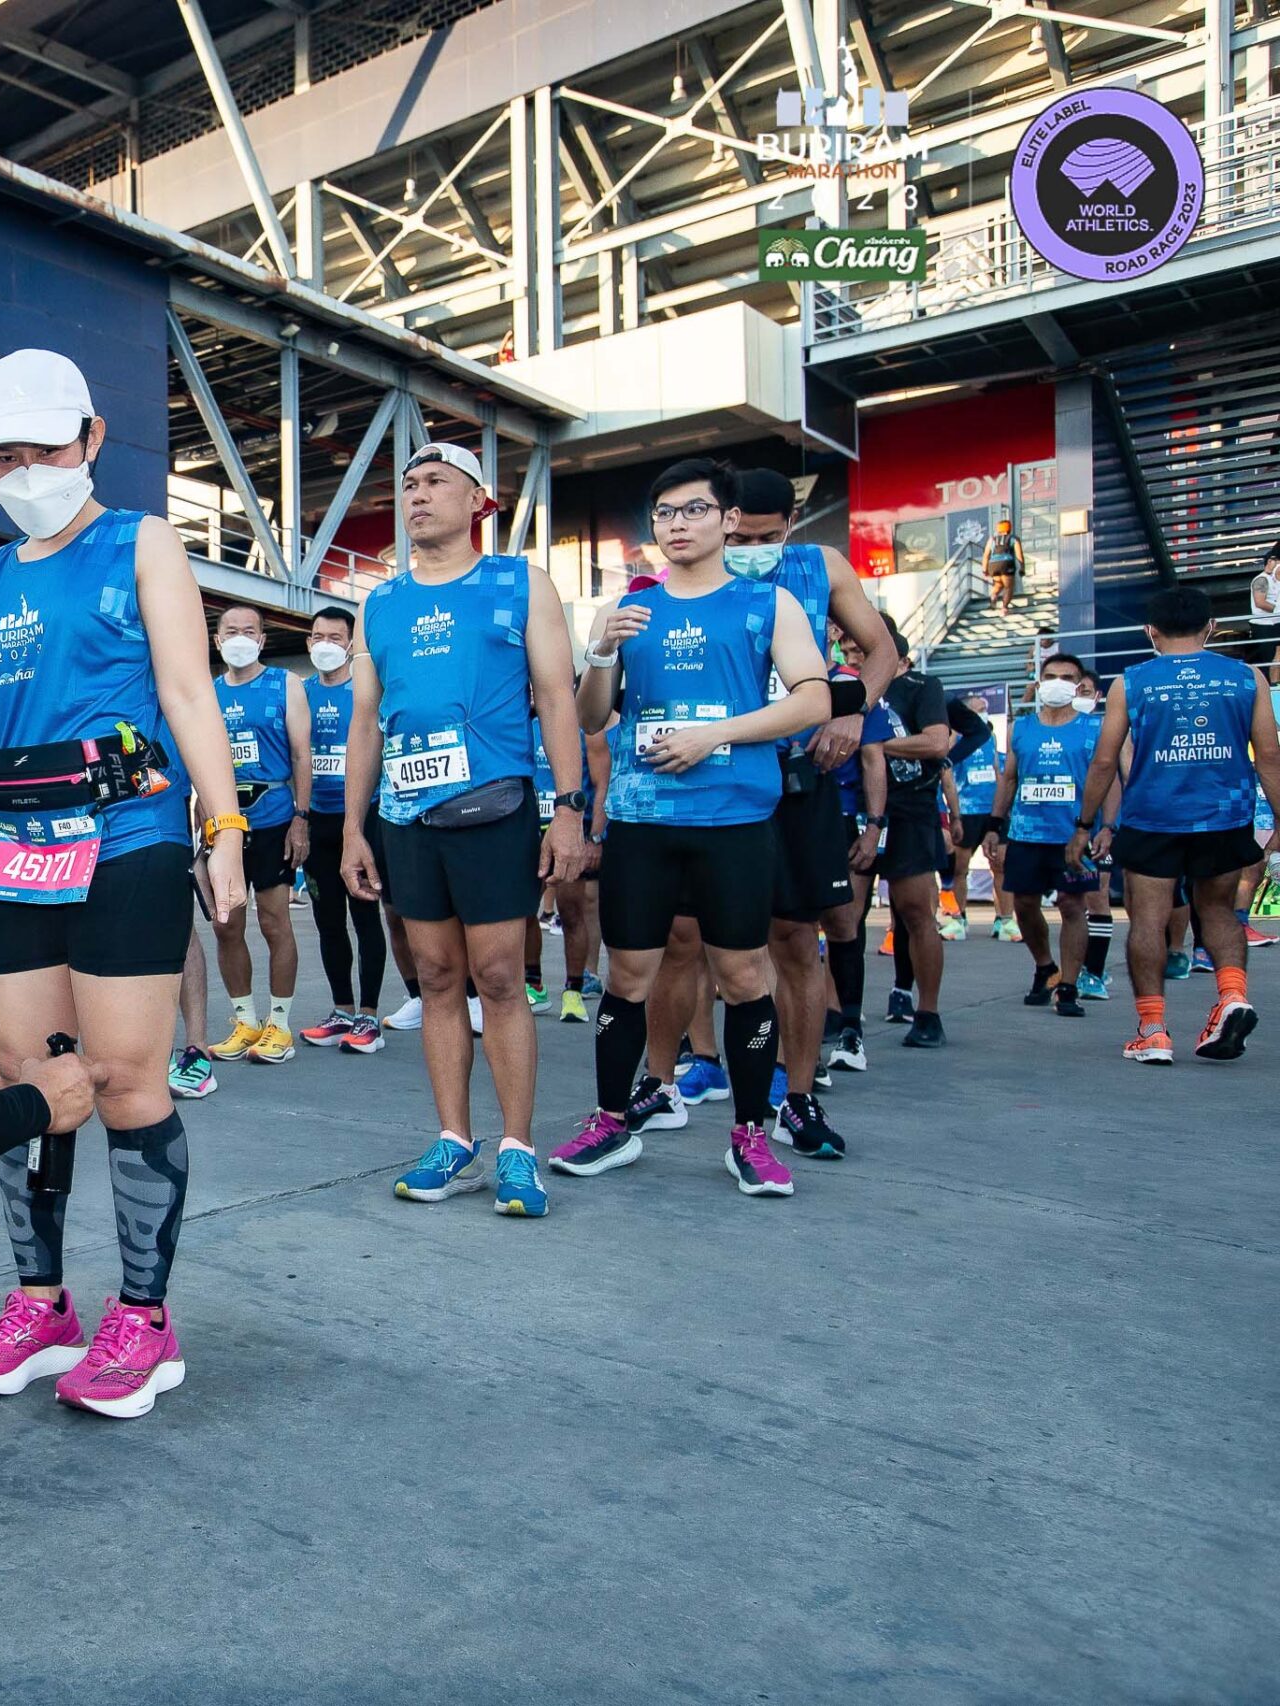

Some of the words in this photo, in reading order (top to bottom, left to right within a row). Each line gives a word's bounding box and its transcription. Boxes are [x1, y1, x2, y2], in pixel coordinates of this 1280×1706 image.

[410, 619, 455, 634] BURIRAM
[662, 635, 707, 647] BURIRAM
[1170, 732, 1216, 748] 42.195
[1155, 746, 1232, 763] MARATHON
[400, 755, 451, 784] 41957
[1032, 787, 1065, 798] 41749
[2, 849, 78, 883] 45171
